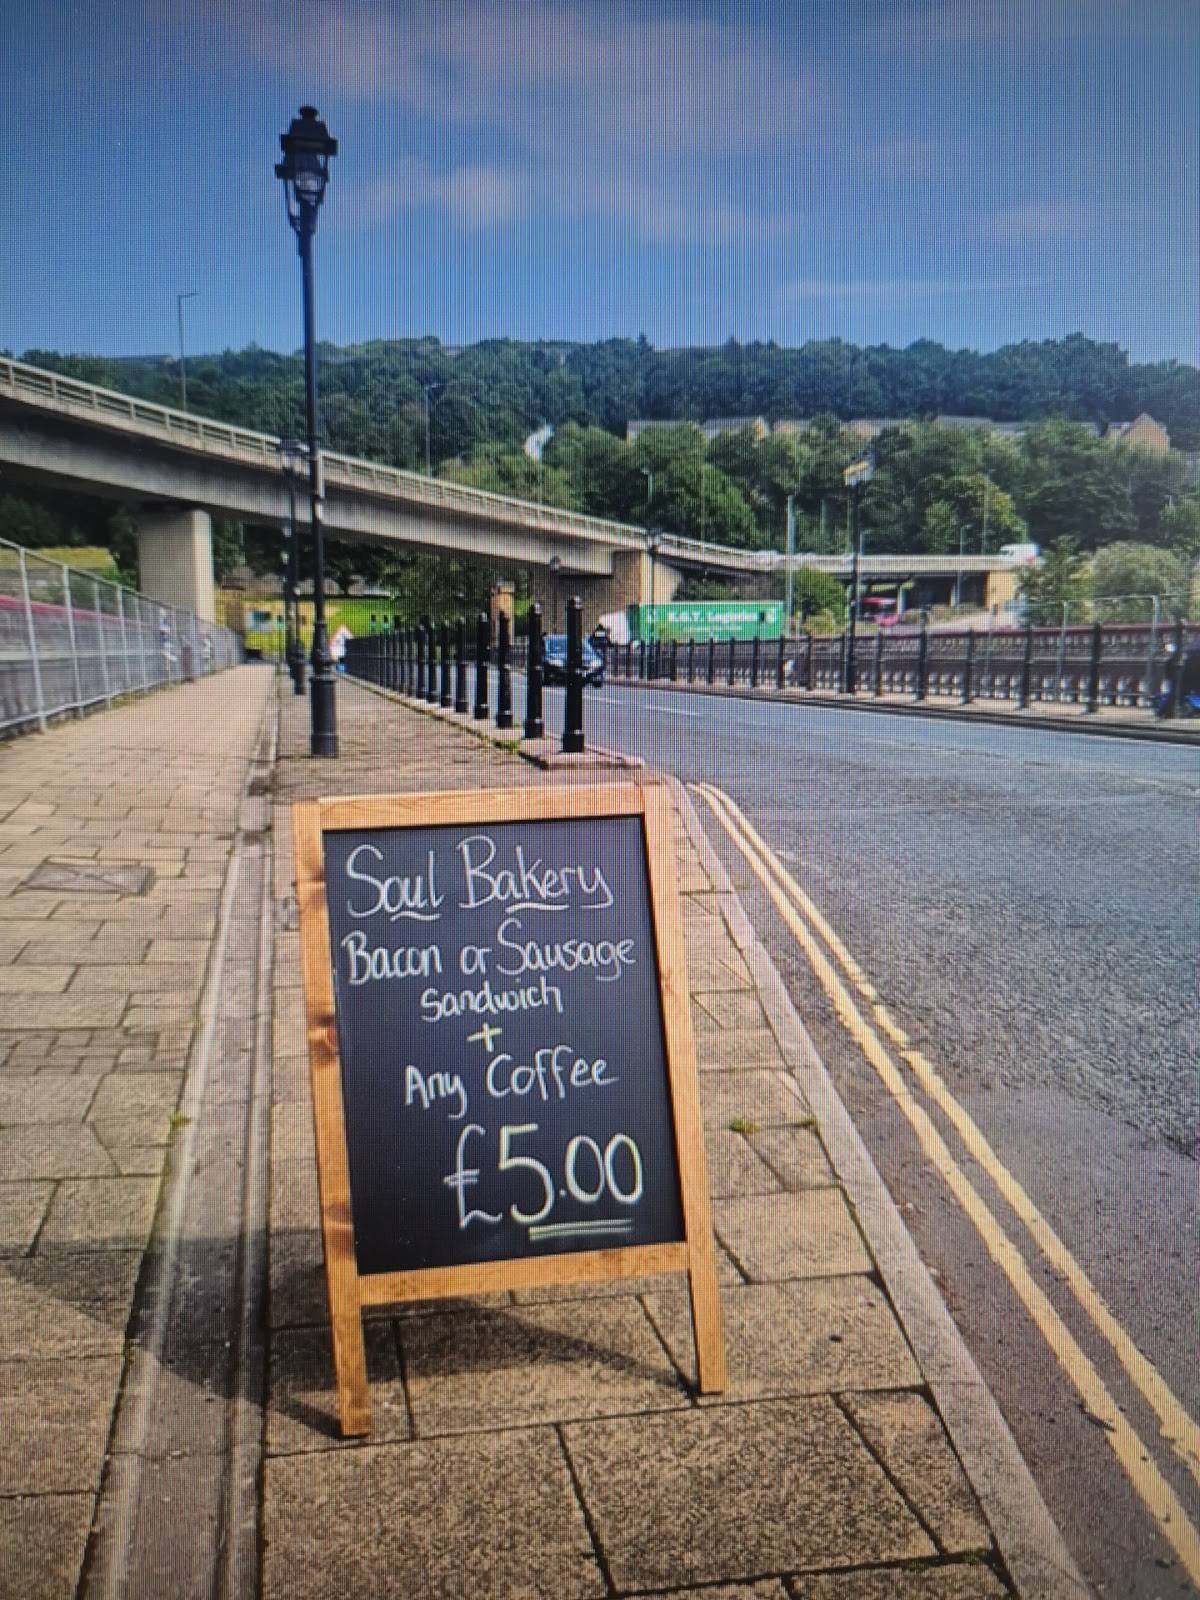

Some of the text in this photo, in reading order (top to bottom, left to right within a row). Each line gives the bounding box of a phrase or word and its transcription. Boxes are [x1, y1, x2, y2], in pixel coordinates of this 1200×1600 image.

[345, 834, 614, 919] Soul Bakery
[341, 917, 638, 985] Bacon or Sausage
[405, 1045, 619, 1120] Any Coffee
[443, 1123, 644, 1229] £5.00
